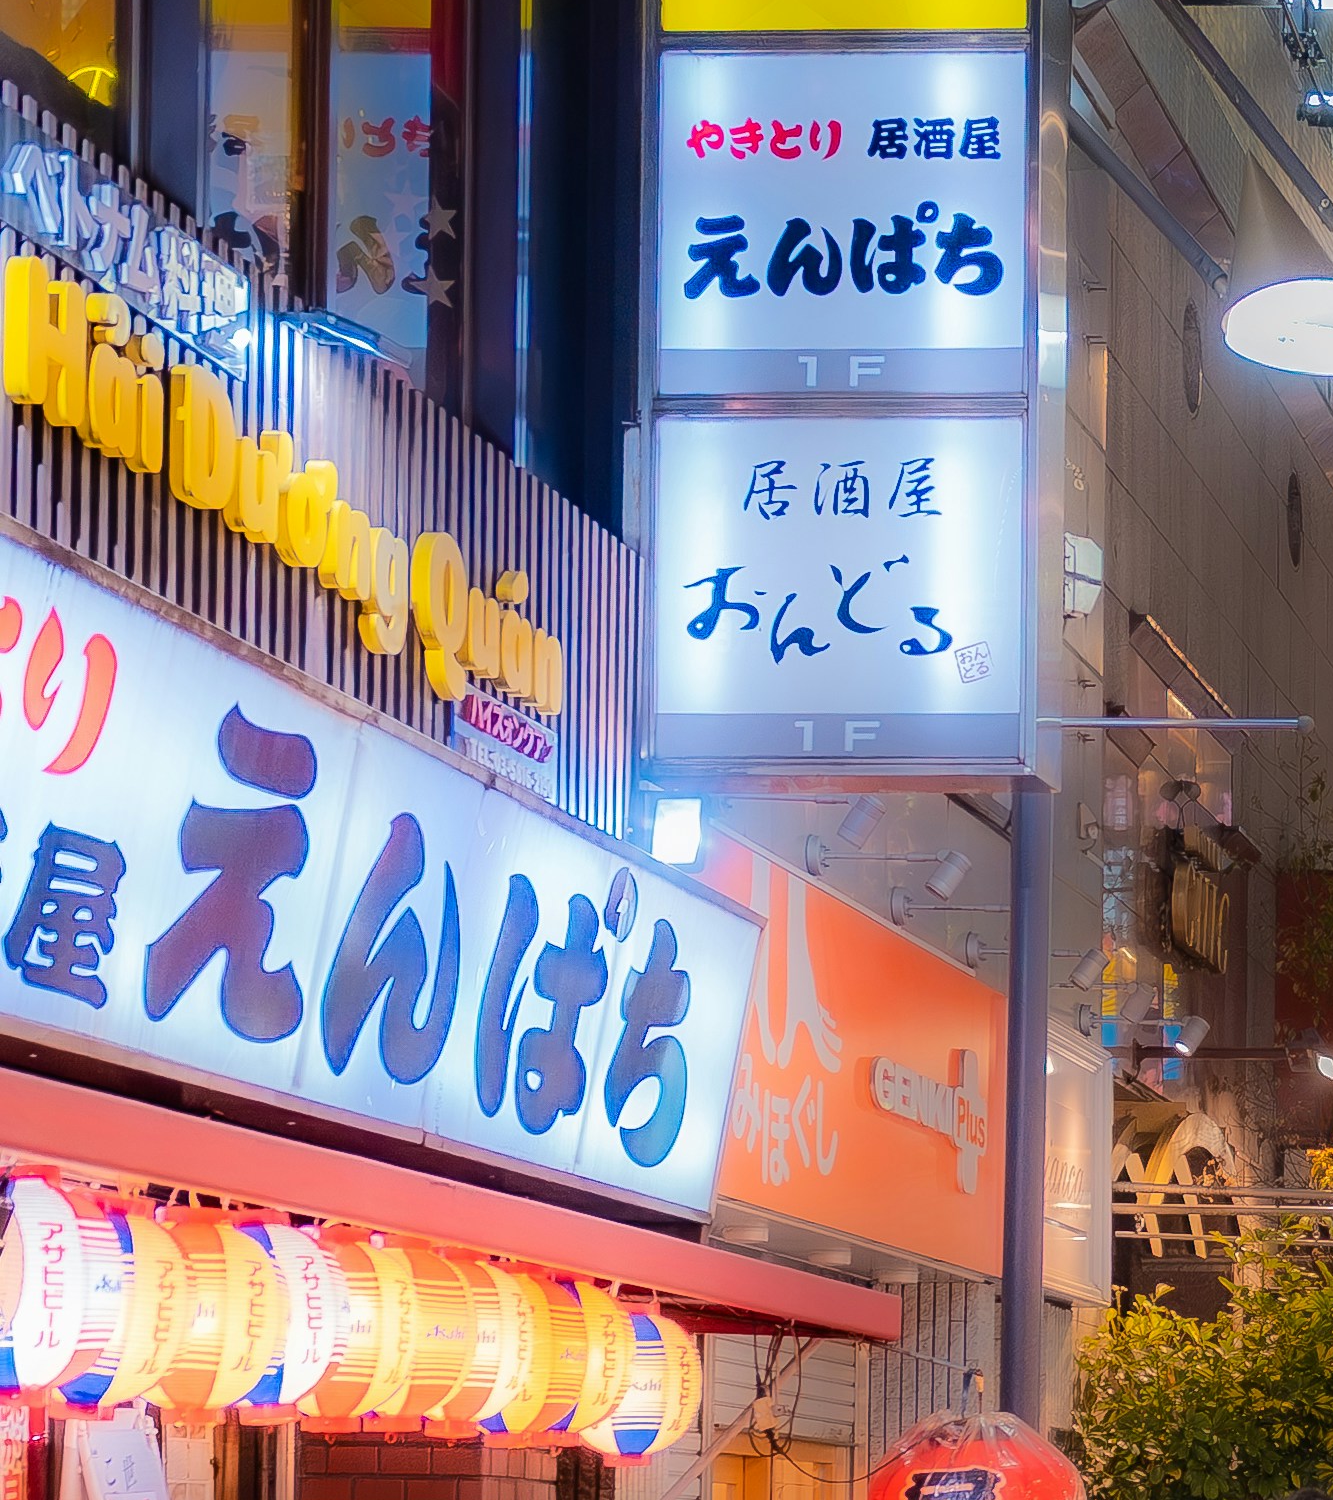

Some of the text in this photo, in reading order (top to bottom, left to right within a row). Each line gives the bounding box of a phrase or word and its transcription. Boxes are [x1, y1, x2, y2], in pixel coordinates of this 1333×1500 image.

[686, 116, 1002, 161] やきとり 居酒屋
[682, 201, 1005, 300] えんぱち
[797, 355, 885, 387] 1F
[743, 457, 943, 520] 居酒屋
[683, 555, 953, 664] おんどる
[794, 719, 880, 751] 1F
[0, 823, 127, 1009] 屋
[144, 704, 690, 1167] えんぱち
[871, 1056, 954, 1138] GENKI
[34, 1222, 66, 1348] アサヒビール
[136, 1260, 175, 1375] アサヒビール
[233, 1260, 266, 1372] アサヒビール
[295, 1256, 322, 1364] アサヒビール
